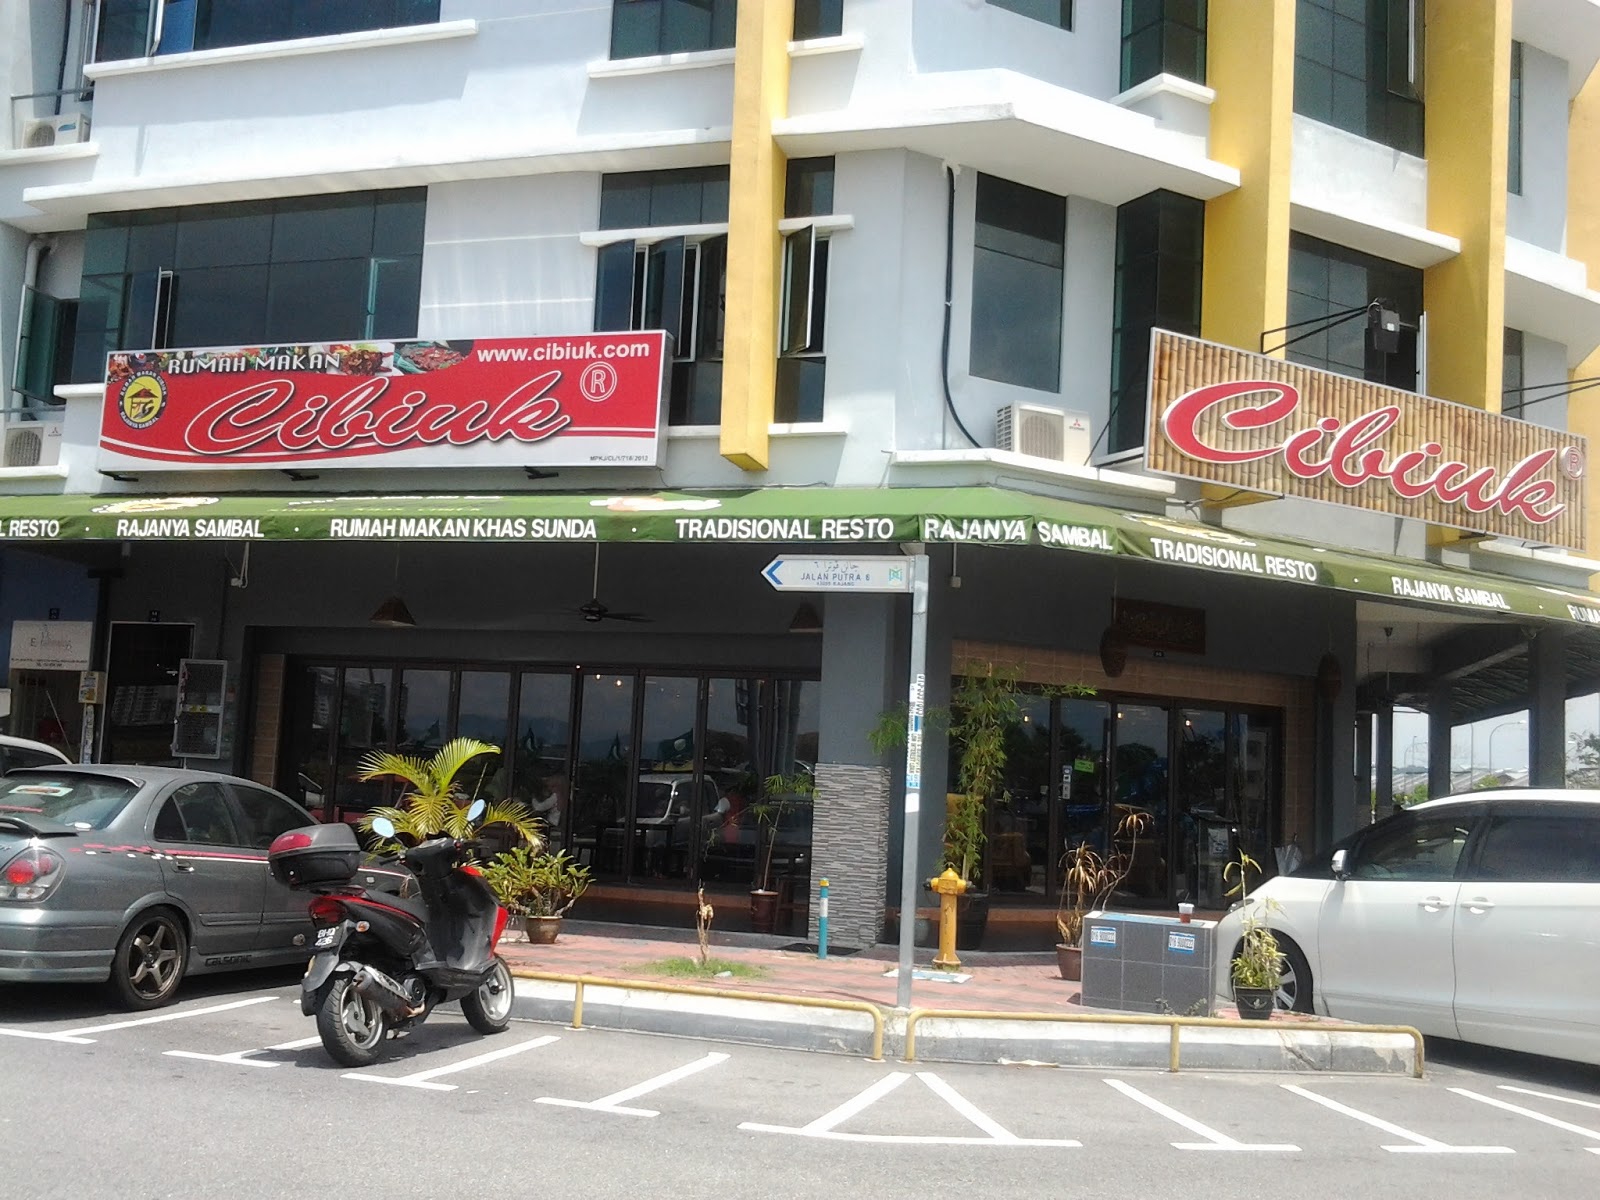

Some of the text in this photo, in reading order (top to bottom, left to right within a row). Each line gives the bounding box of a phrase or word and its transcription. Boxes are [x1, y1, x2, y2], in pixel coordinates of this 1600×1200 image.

[477, 342, 650, 362] www.cibiuk.com
[168, 353, 341, 374] RUMAH MAKAN
[184, 370, 571, 454] Cibiuk
[1161, 379, 1567, 525] Cibiuk
[9, 519, 60, 537] RESTO
[116, 518, 265, 538] RAJANYA SAMBAL
[330, 518, 597, 538] RUMAH MAKAN KHAS SUNDA
[675, 517, 894, 539] TRADISIONAL RESTO
[924, 518, 1113, 550] RAJANYA SAMBAL
[1150, 537, 1318, 582] TRADISIONAL RESTO
[801, 573, 829, 581] JALAN
[832, 573, 861, 581] PUTRA
[1391, 576, 1511, 610] RAJANYA SAMBAL
